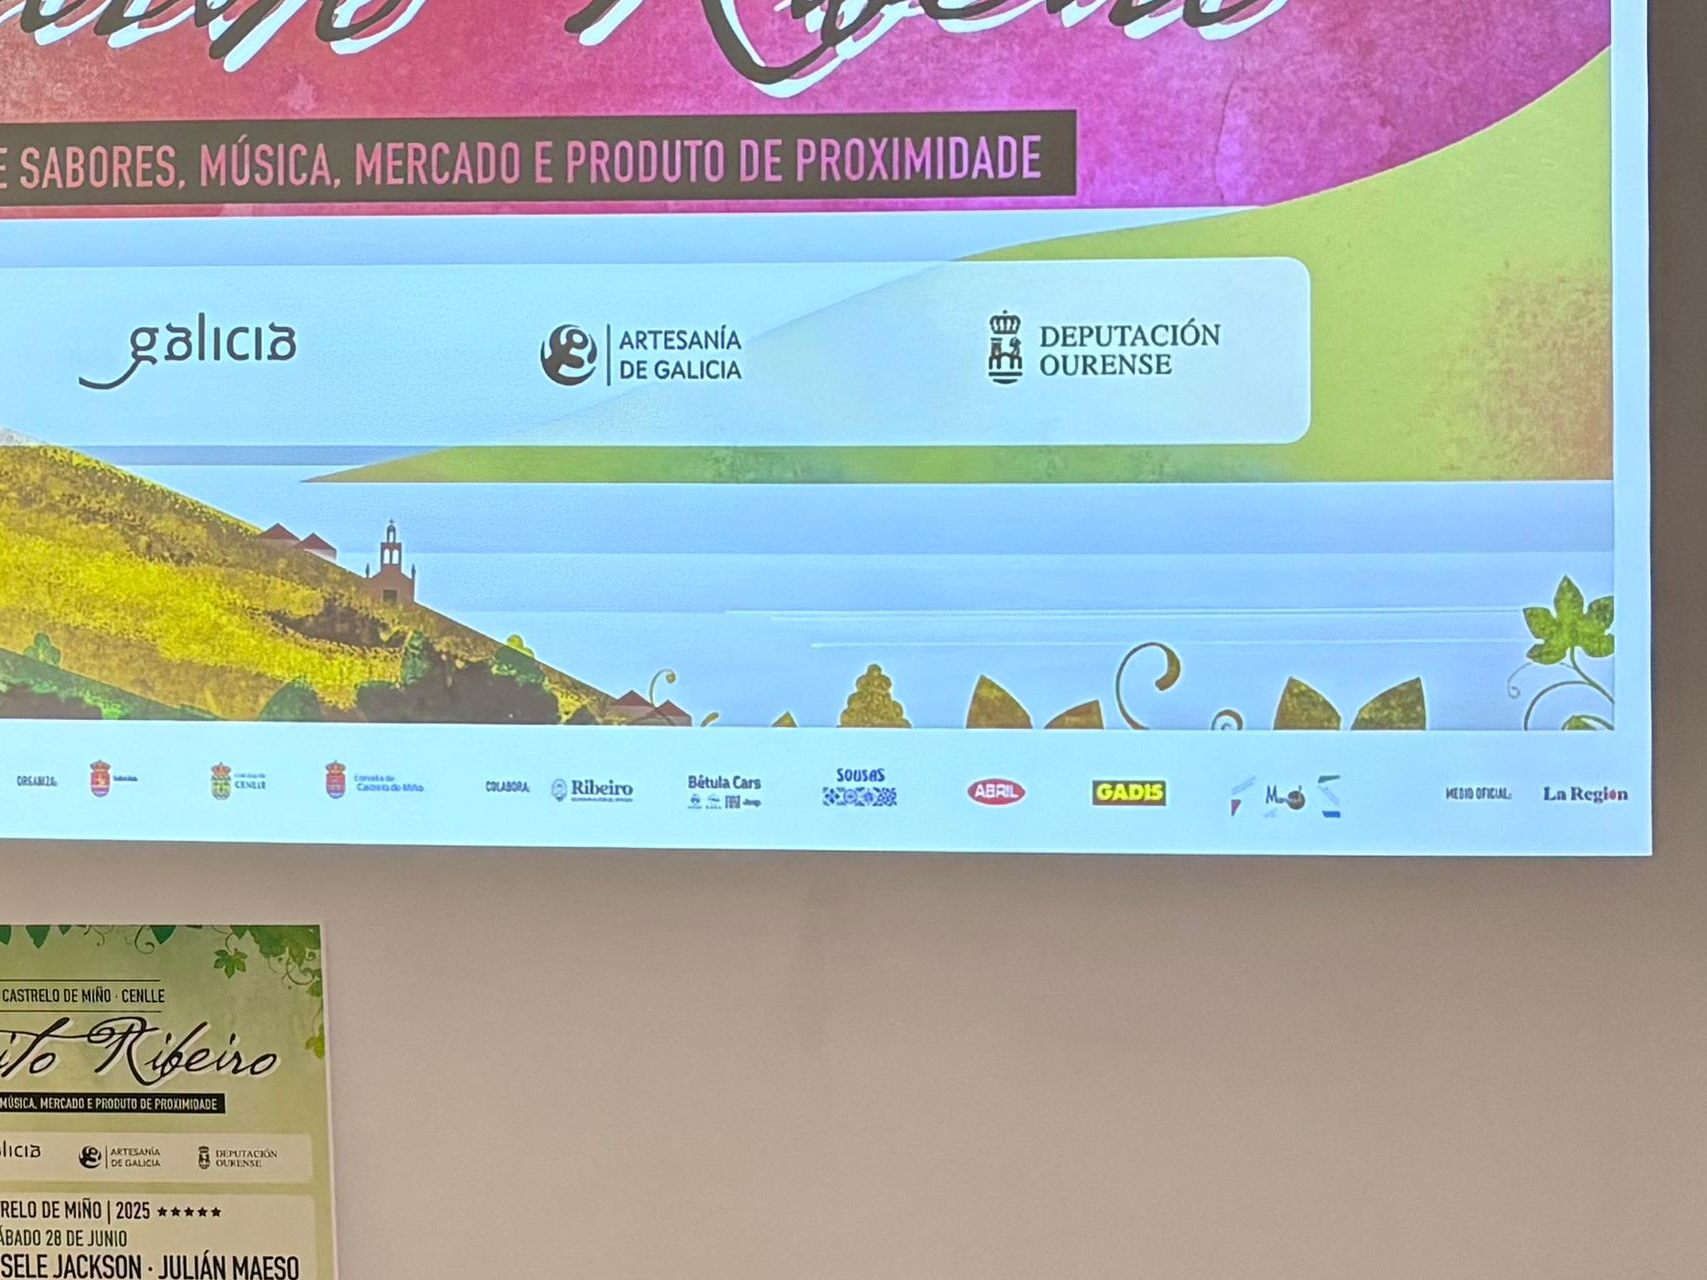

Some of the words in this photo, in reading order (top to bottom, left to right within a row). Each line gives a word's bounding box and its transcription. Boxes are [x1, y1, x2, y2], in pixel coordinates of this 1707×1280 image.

[19, 144, 186, 191] SABORES,
[201, 134, 340, 190] MÚSICA,
[356, 141, 520, 186] MERCADO
[535, 141, 553, 184] E
[567, 139, 725, 184] PRODUTO
[740, 139, 783, 182] DE
[797, 135, 1042, 181] PROXIMIDADE
[619, 323, 742, 351] ARTESANÍA
[1039, 318, 1222, 349] DEPUTACIÓN
[78, 312, 297, 390] galicia
[620, 360, 648, 379] DE
[654, 358, 742, 381] GALICIA
[1039, 349, 1173, 377] OURENSE
[733, 776, 761, 789] Cars
[837, 768, 885, 782] SOUSAS
[571, 780, 633, 796] Ribeiro
[974, 784, 1019, 799] ABRIL
[1097, 783, 1164, 801] GADIS
[1544, 787, 1566, 801] La
[2, 988, 60, 1003] CASTRELO
[63, 989, 78, 1003] DE
[81, 986, 111, 1003] MIÑO
[122, 989, 165, 1004] CENLLE
[87, 1016, 279, 1086] Ribeiro
[41, 1097, 85, 1110] MERCADO
[87, 1098, 92, 1109] E
[95, 1098, 137, 1110] PRODUTO
[140, 1098, 152, 1110] DE
[155, 1098, 218, 1111] PROXIMIDADE
[111, 1146, 160, 1157] ARTESANÍA
[215, 1147, 277, 1158] DEPUTACIÓN
[111, 1158, 123, 1167] DE
[125, 1157, 161, 1167] GALICIA
[215, 1158, 262, 1168] OURENSE
[42, 1201, 61, 1219] DE
[65, 1198, 102, 1219] MIÑO
[116, 1202, 150, 1220] 2025
[45, 1230, 63, 1247] 28
[66, 1230, 83, 1247] DE
[87, 1230, 127, 1248] JUNIO
[53, 1255, 141, 1279] JACKSON
[158, 1250, 226, 1280] JULIÁN
[232, 1256, 299, 1280] MAESO
